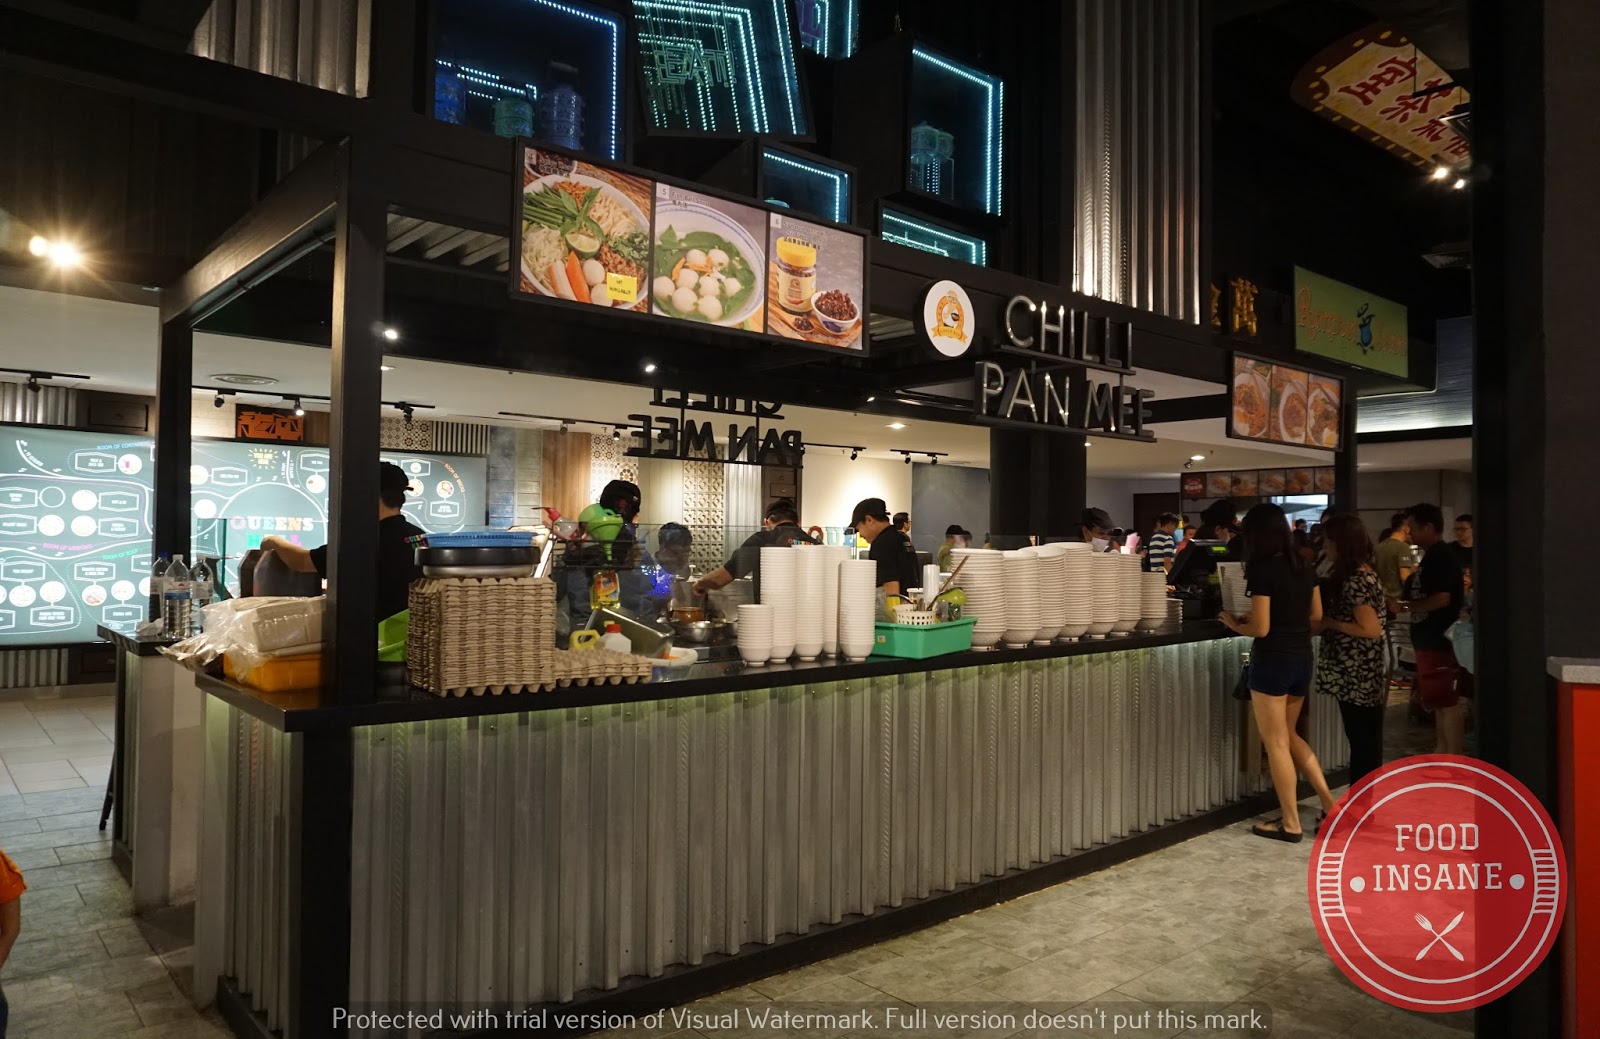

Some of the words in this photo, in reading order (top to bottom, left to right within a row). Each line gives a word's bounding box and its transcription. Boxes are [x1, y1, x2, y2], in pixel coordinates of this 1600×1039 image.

[1005, 295, 1134, 369] CHILLI
[976, 361, 1070, 427] PAN
[1084, 380, 1155, 436] MEE
[231, 515, 314, 531] QUEENS
[246, 534, 302, 547] HL
